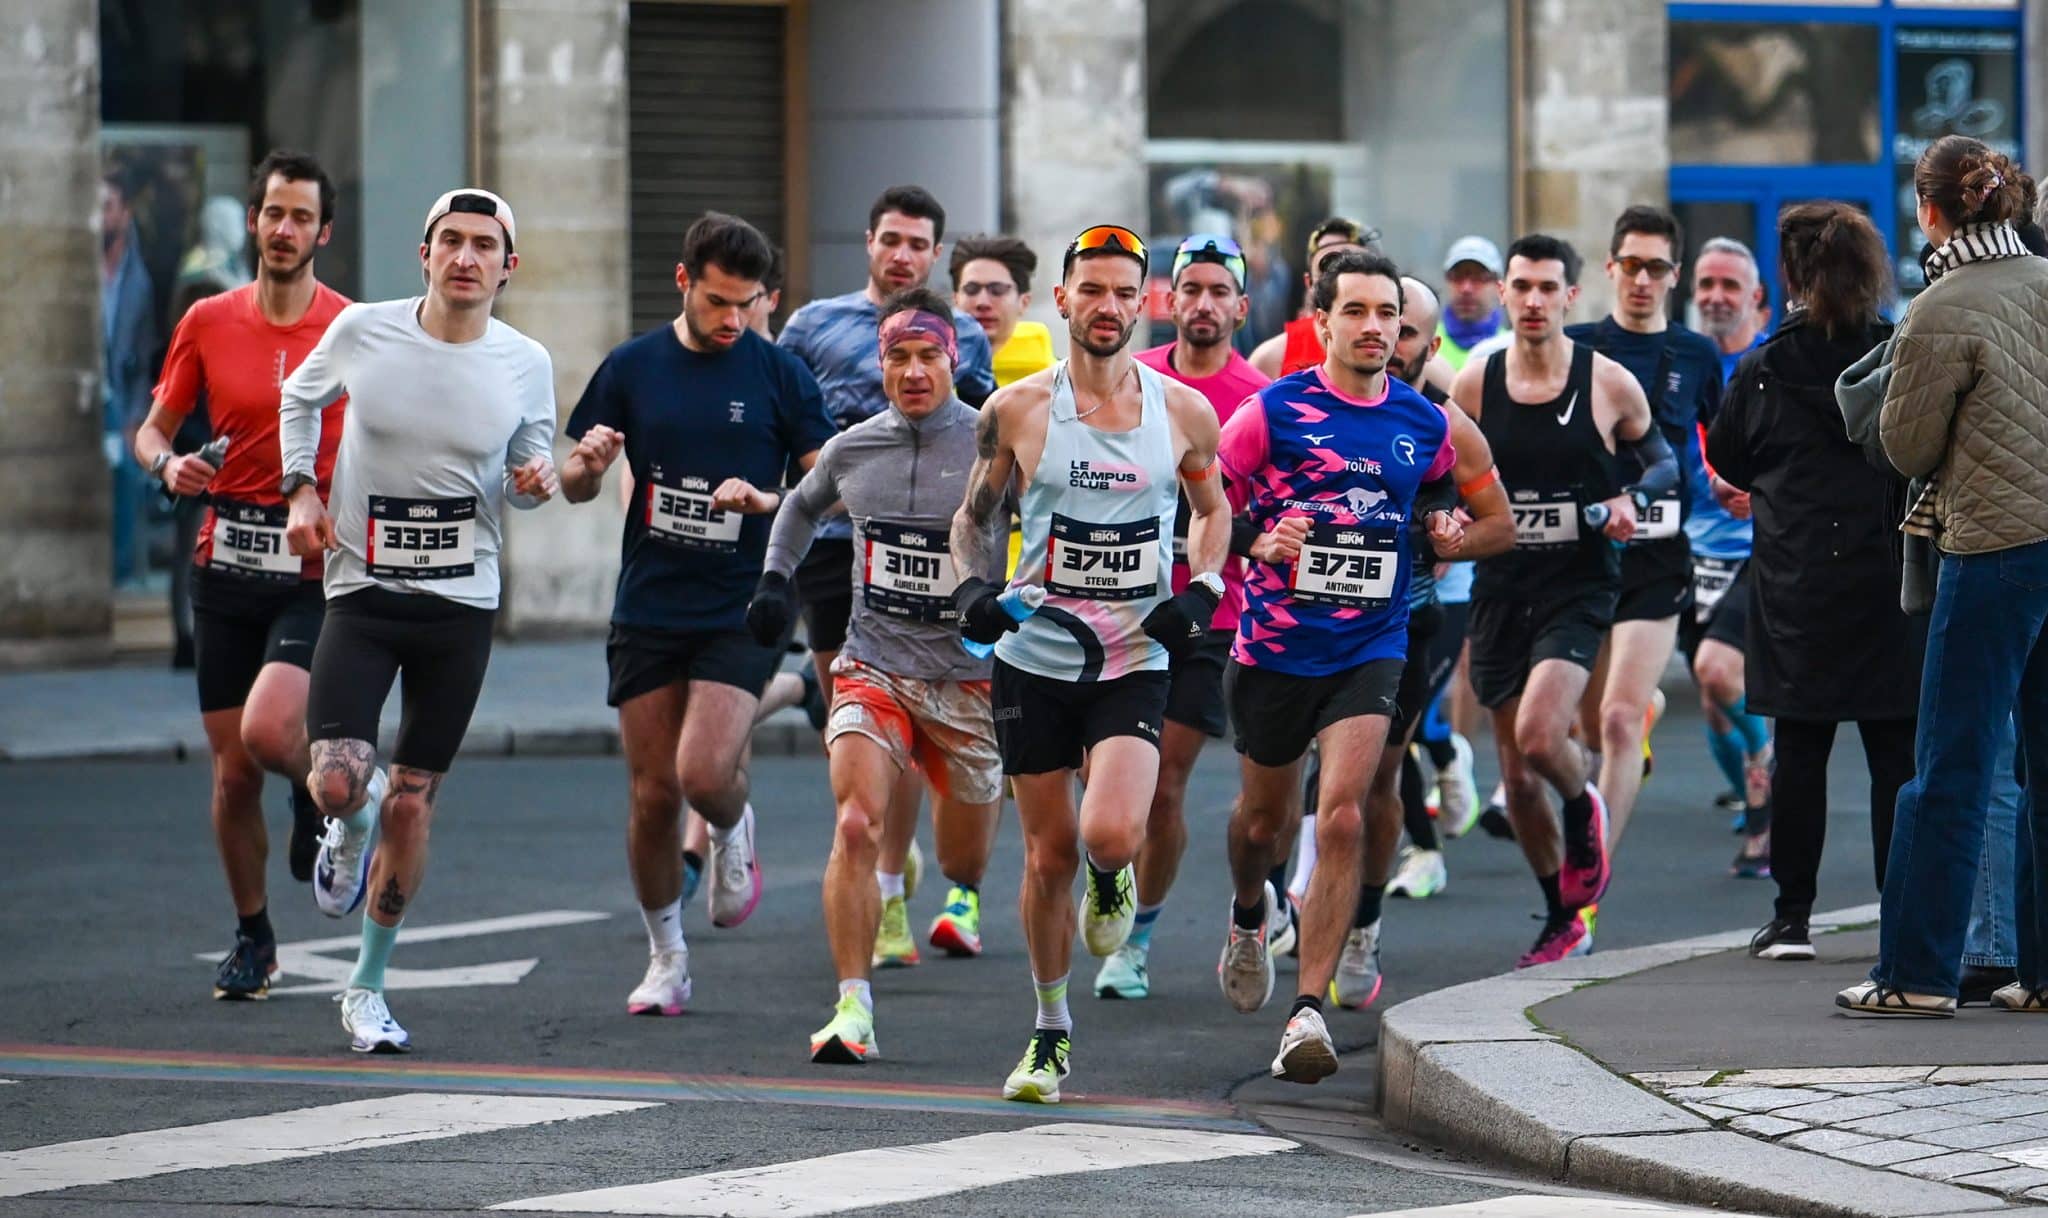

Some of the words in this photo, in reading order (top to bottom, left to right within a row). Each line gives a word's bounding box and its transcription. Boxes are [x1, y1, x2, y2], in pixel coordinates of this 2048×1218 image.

[1071, 460, 1089, 470] LE
[1344, 460, 1382, 475] TOURS
[1070, 470, 1136, 482] CAMPUS
[1069, 479, 1110, 490] CLUB
[408, 507, 438, 519] 19KM
[1282, 499, 1347, 514] FREERUN
[1512, 508, 1560, 529] 776
[223, 525, 281, 555] 3851
[384, 525, 459, 550] 3335
[899, 533, 927, 547] 19KM
[1089, 531, 1120, 543] 19KM
[1336, 533, 1365, 546] 19KM
[414, 554, 430, 565] LEO
[885, 549, 941, 580] 3101
[1062, 545, 1141, 573] 3740
[1308, 551, 1383, 580] 3736
[893, 578, 930, 592] AURELIEN
[1084, 576, 1119, 587] STEVEN
[1325, 581, 1364, 595] ANTHONY
